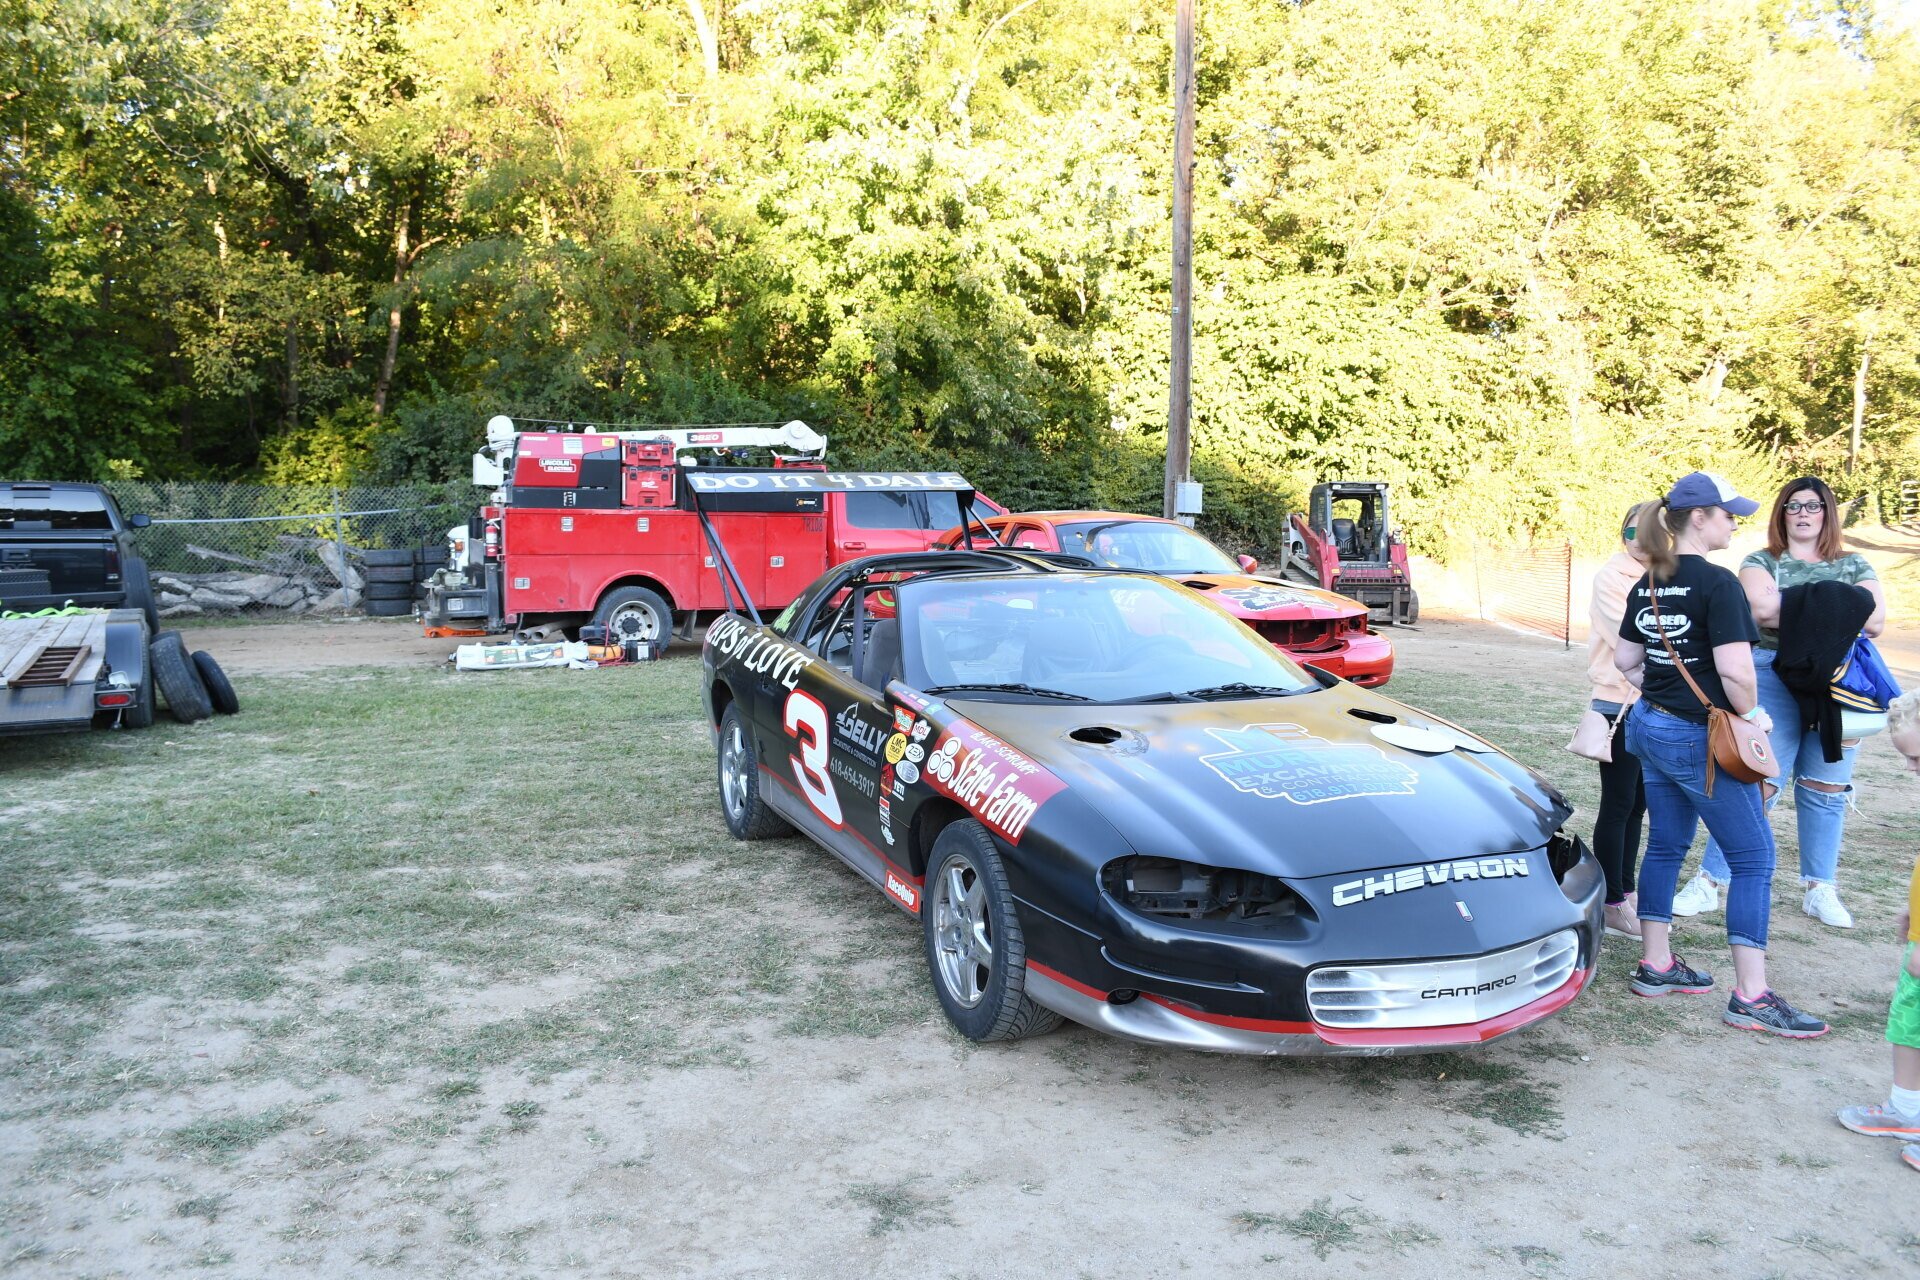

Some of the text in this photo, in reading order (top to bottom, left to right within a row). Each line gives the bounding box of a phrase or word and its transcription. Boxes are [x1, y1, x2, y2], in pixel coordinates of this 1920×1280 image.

[690, 433, 720, 442] 3820
[690, 474, 971, 489] DO IT 4 DALE
[732, 631, 763, 660] of
[743, 637, 815, 691] LOVE
[836, 716, 888, 755] GELLY
[891, 736, 906, 749] LMC
[969, 731, 1040, 775] BLAKE SCHRUMPF
[783, 689, 844, 829] 3
[829, 756, 875, 799] 618-654-3917
[1235, 763, 1409, 788] EXCAVATION
[947, 747, 1038, 838] State Farm
[1332, 858, 1530, 907] CHEVRON
[1420, 974, 1517, 999] CAMARO
